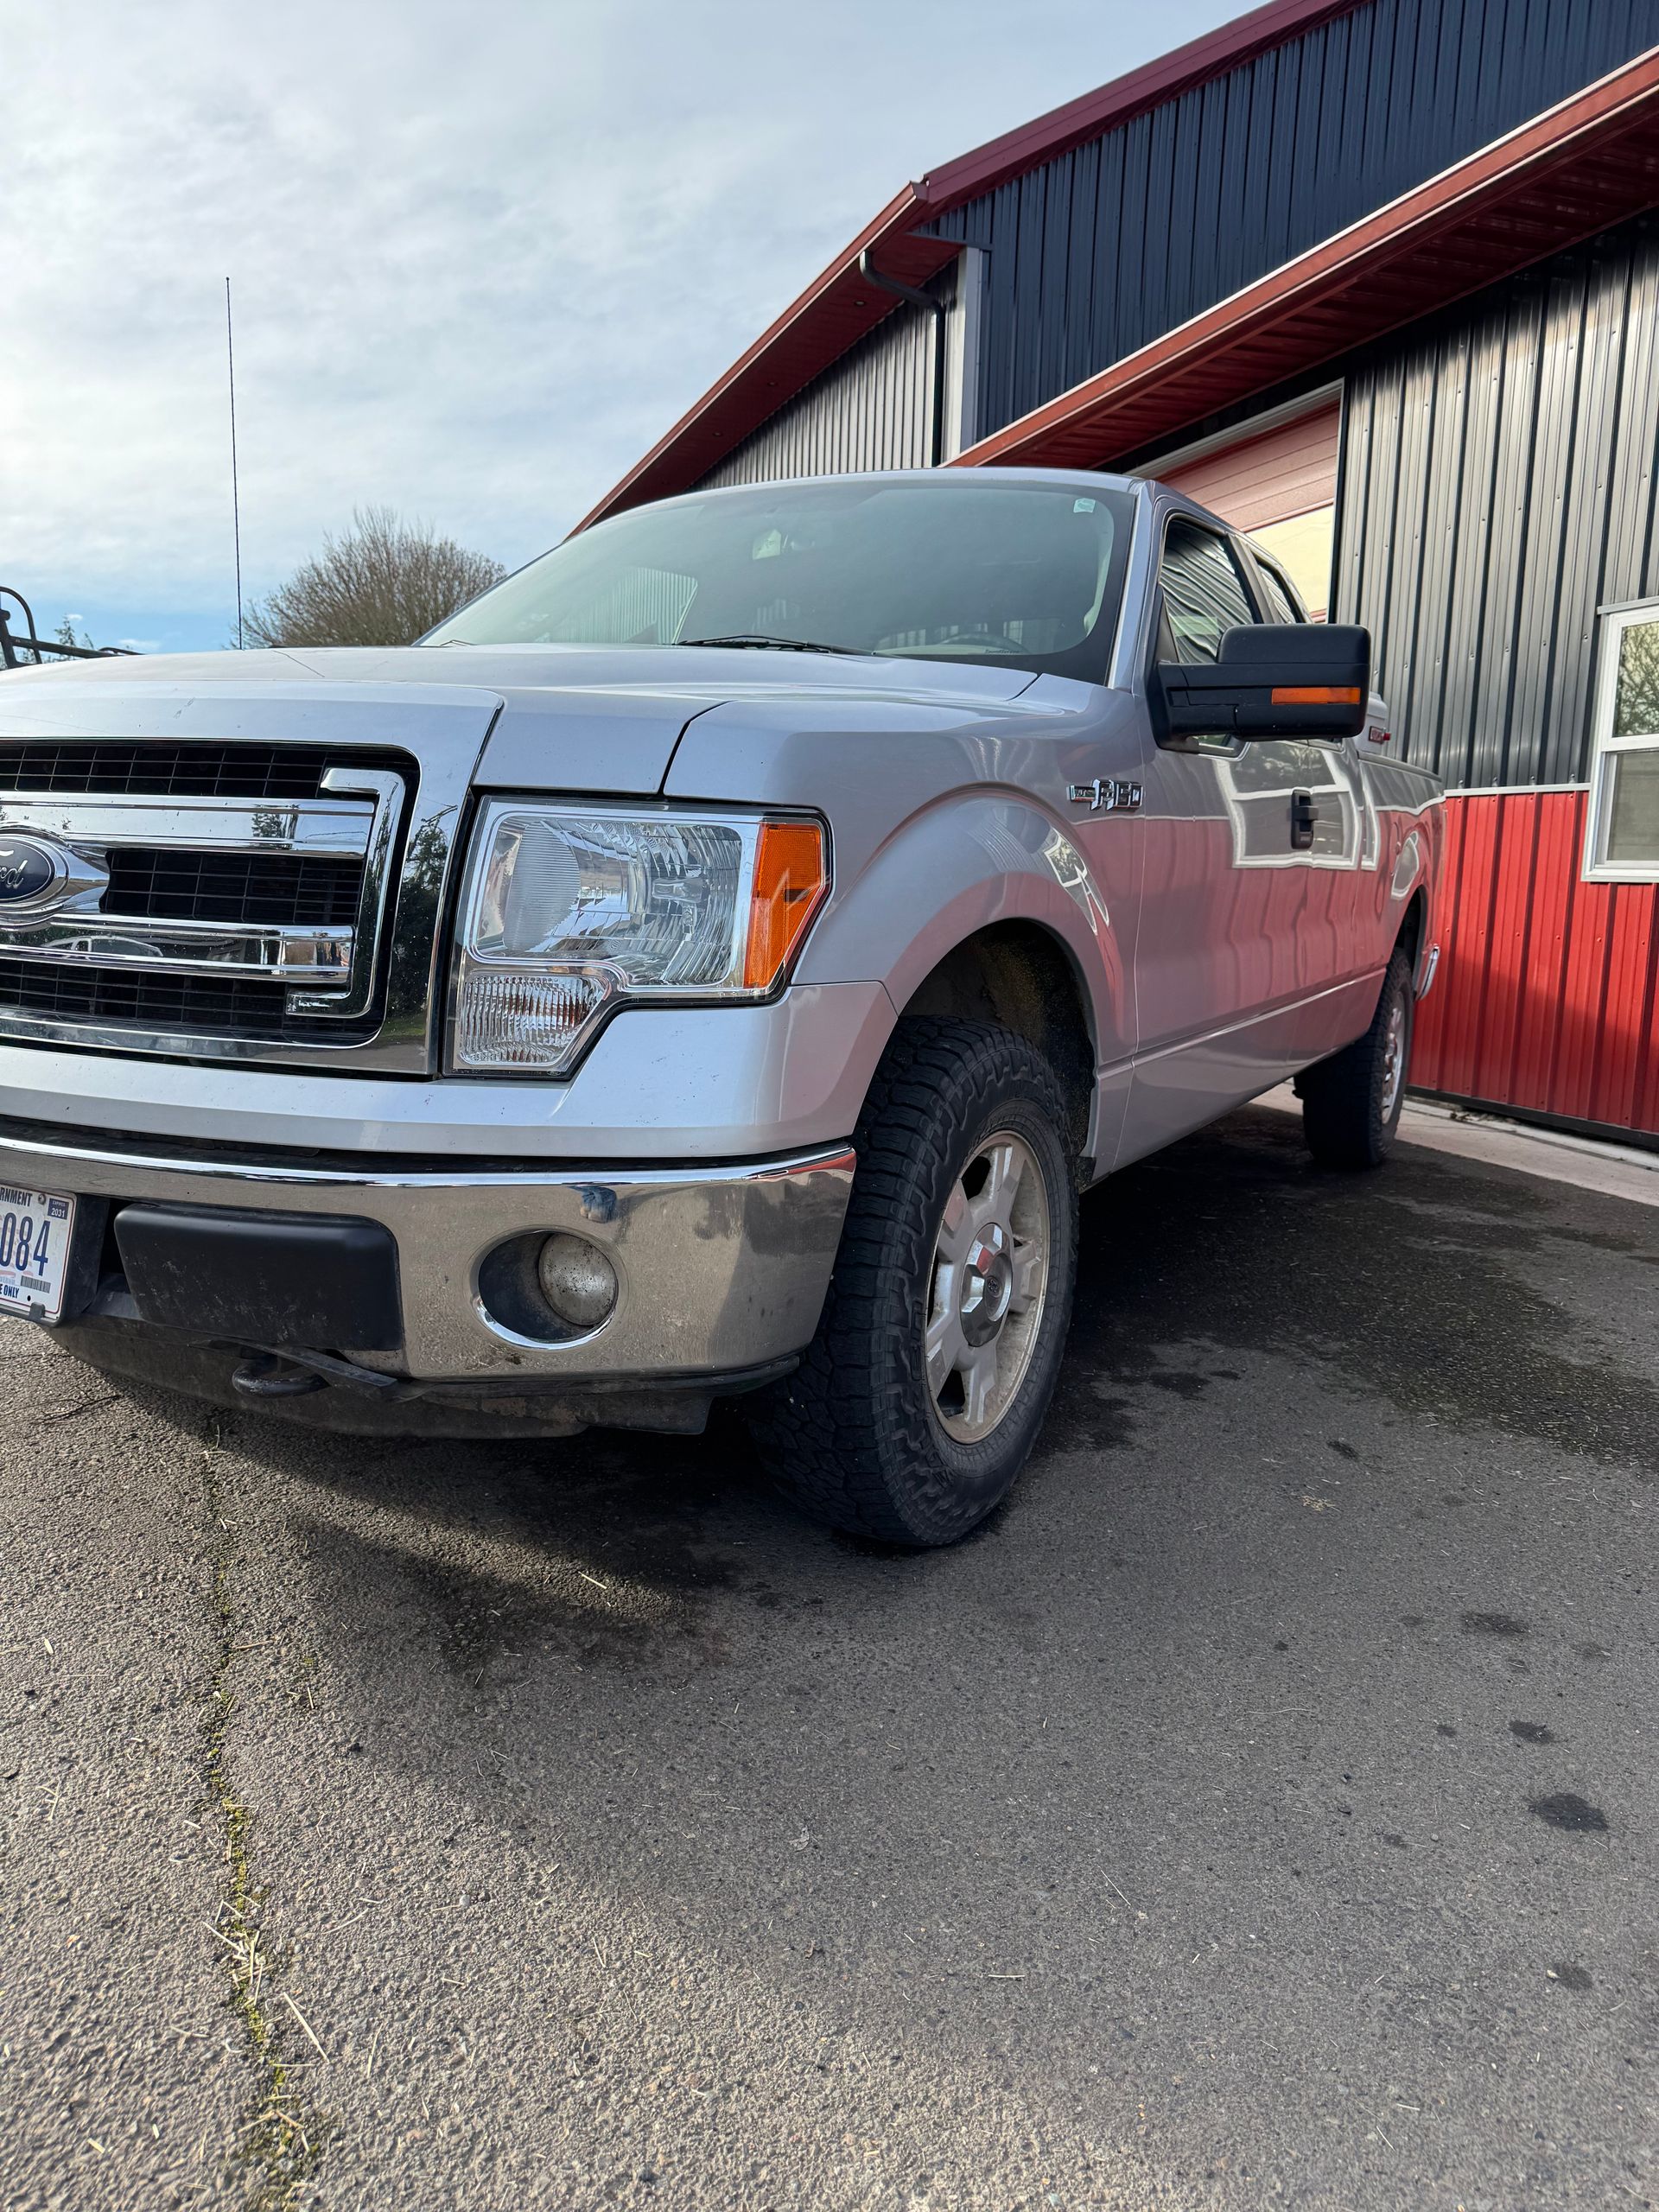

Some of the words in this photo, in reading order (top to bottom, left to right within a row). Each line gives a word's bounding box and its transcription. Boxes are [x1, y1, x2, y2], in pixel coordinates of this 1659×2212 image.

[52, 1208, 65, 1217] 2031
[0, 1212, 50, 1276] 084
[3, 1285, 19, 1299] ONLY
